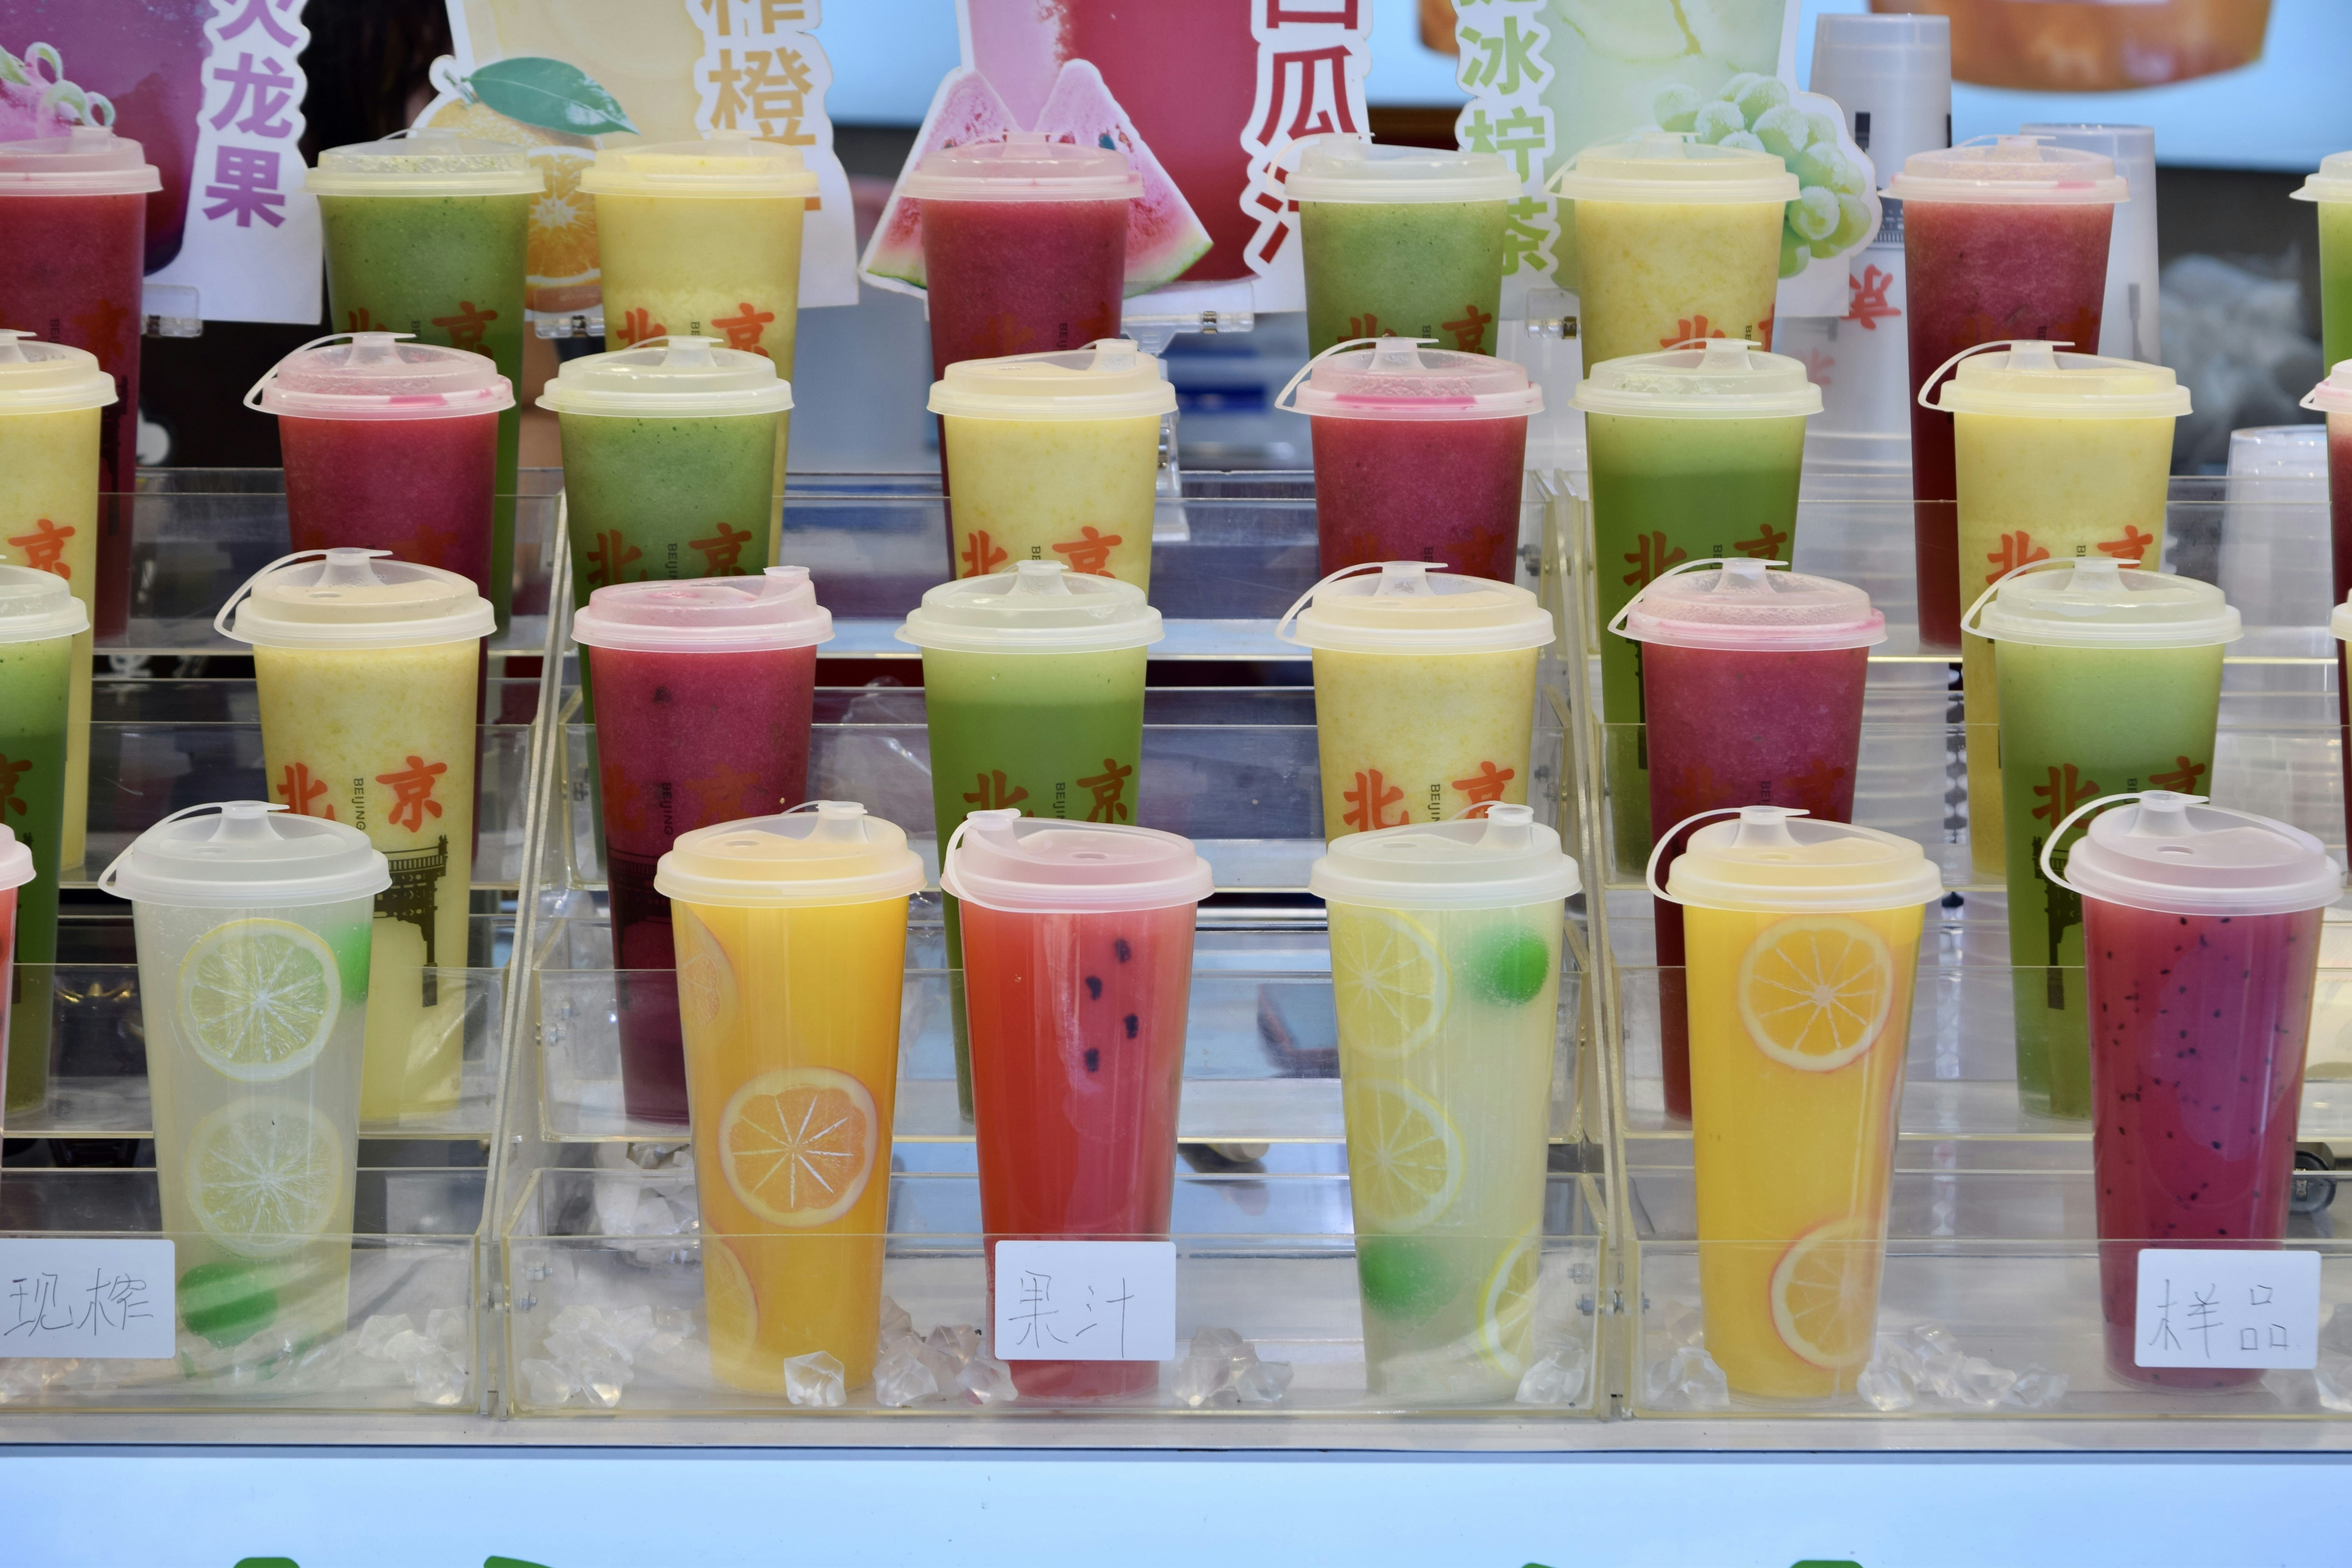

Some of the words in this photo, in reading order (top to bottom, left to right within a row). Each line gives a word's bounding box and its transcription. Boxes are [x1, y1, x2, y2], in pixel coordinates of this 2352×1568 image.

[277, 756, 448, 832] 北京
[352, 778, 367, 831] BEIJING
[4, 1268, 153, 1337] 现榨
[1009, 1270, 1134, 1358] 果汁
[2148, 1279, 2289, 1359] 样品
